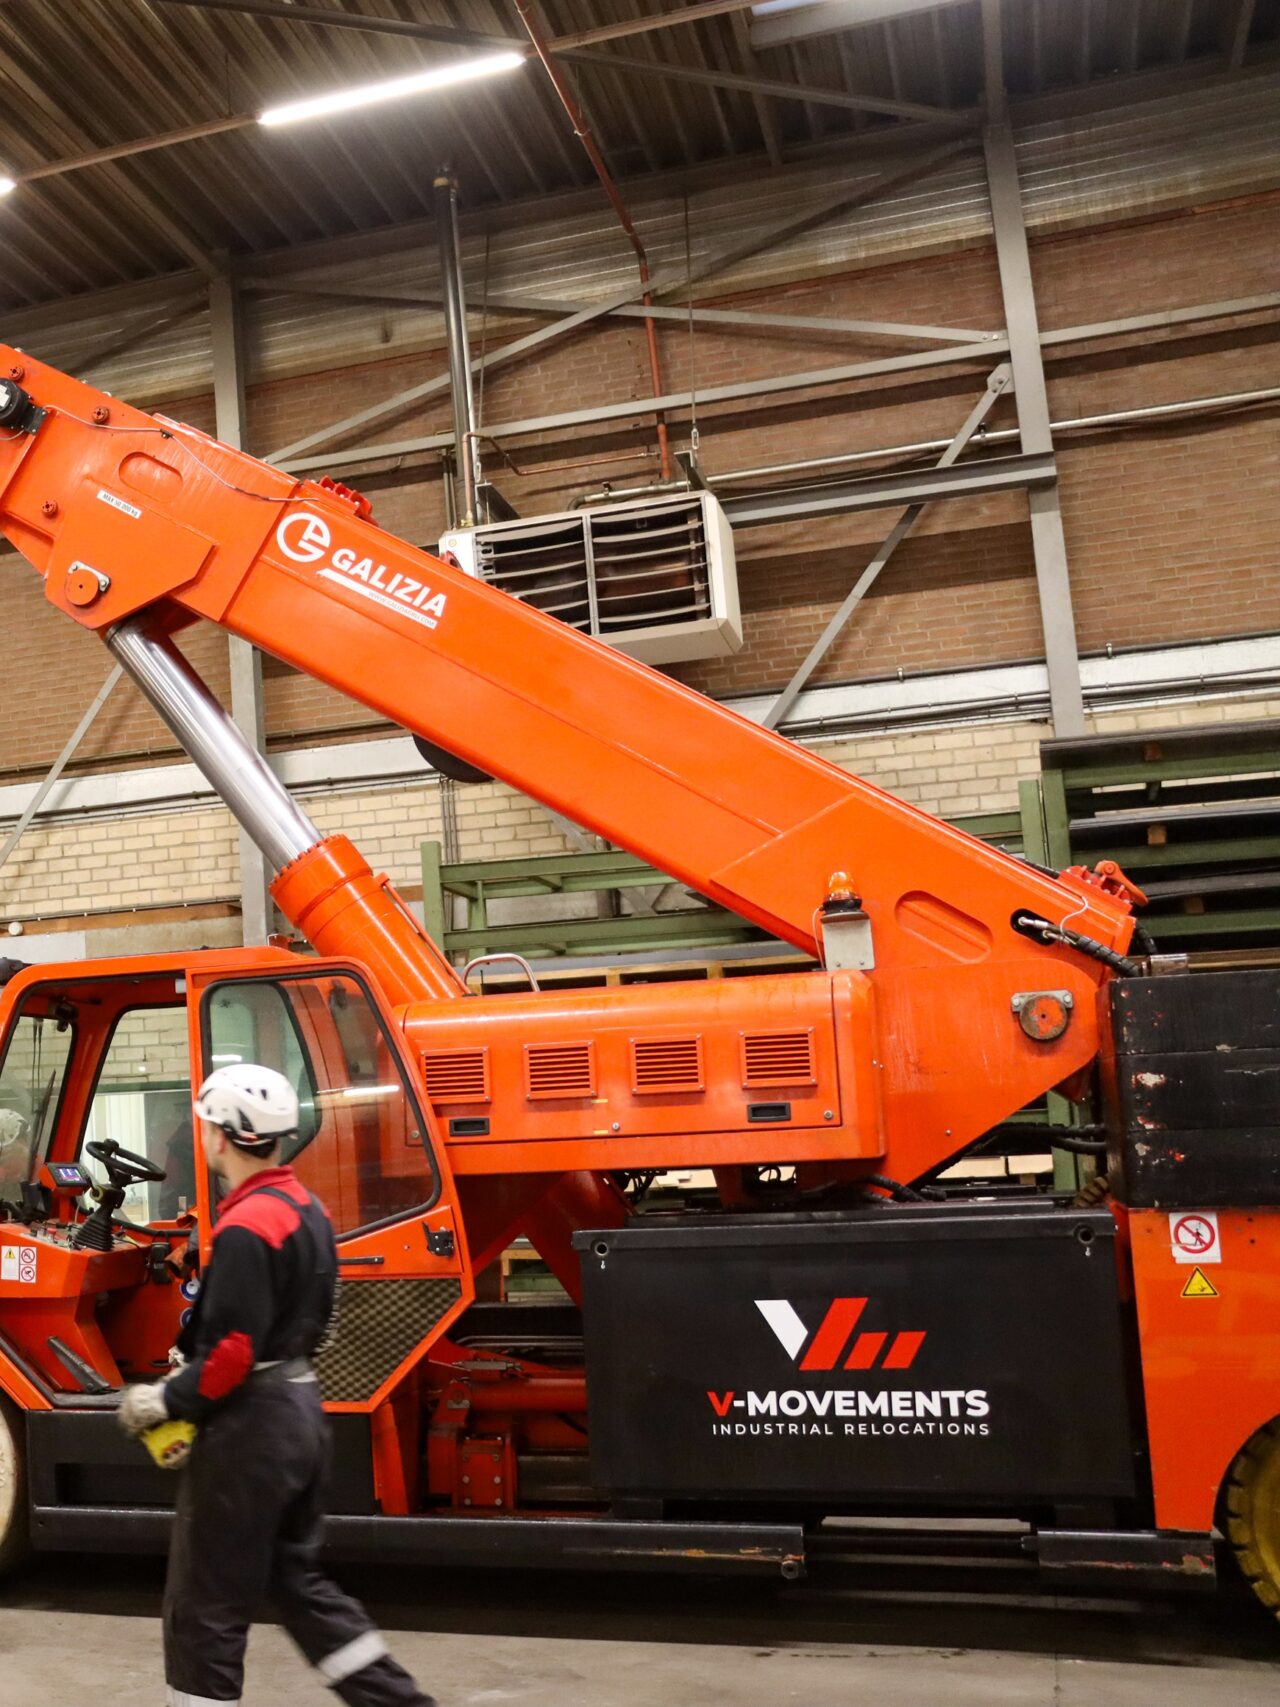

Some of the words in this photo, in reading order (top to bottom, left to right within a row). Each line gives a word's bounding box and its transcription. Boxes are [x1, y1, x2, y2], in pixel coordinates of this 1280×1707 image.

[331, 548, 448, 618] GALIZIA
[706, 1389, 991, 1418] V-MOVEMENTS
[712, 1422, 834, 1436] INDUSTRIAL
[844, 1422, 990, 1436] RELOCATIONS
